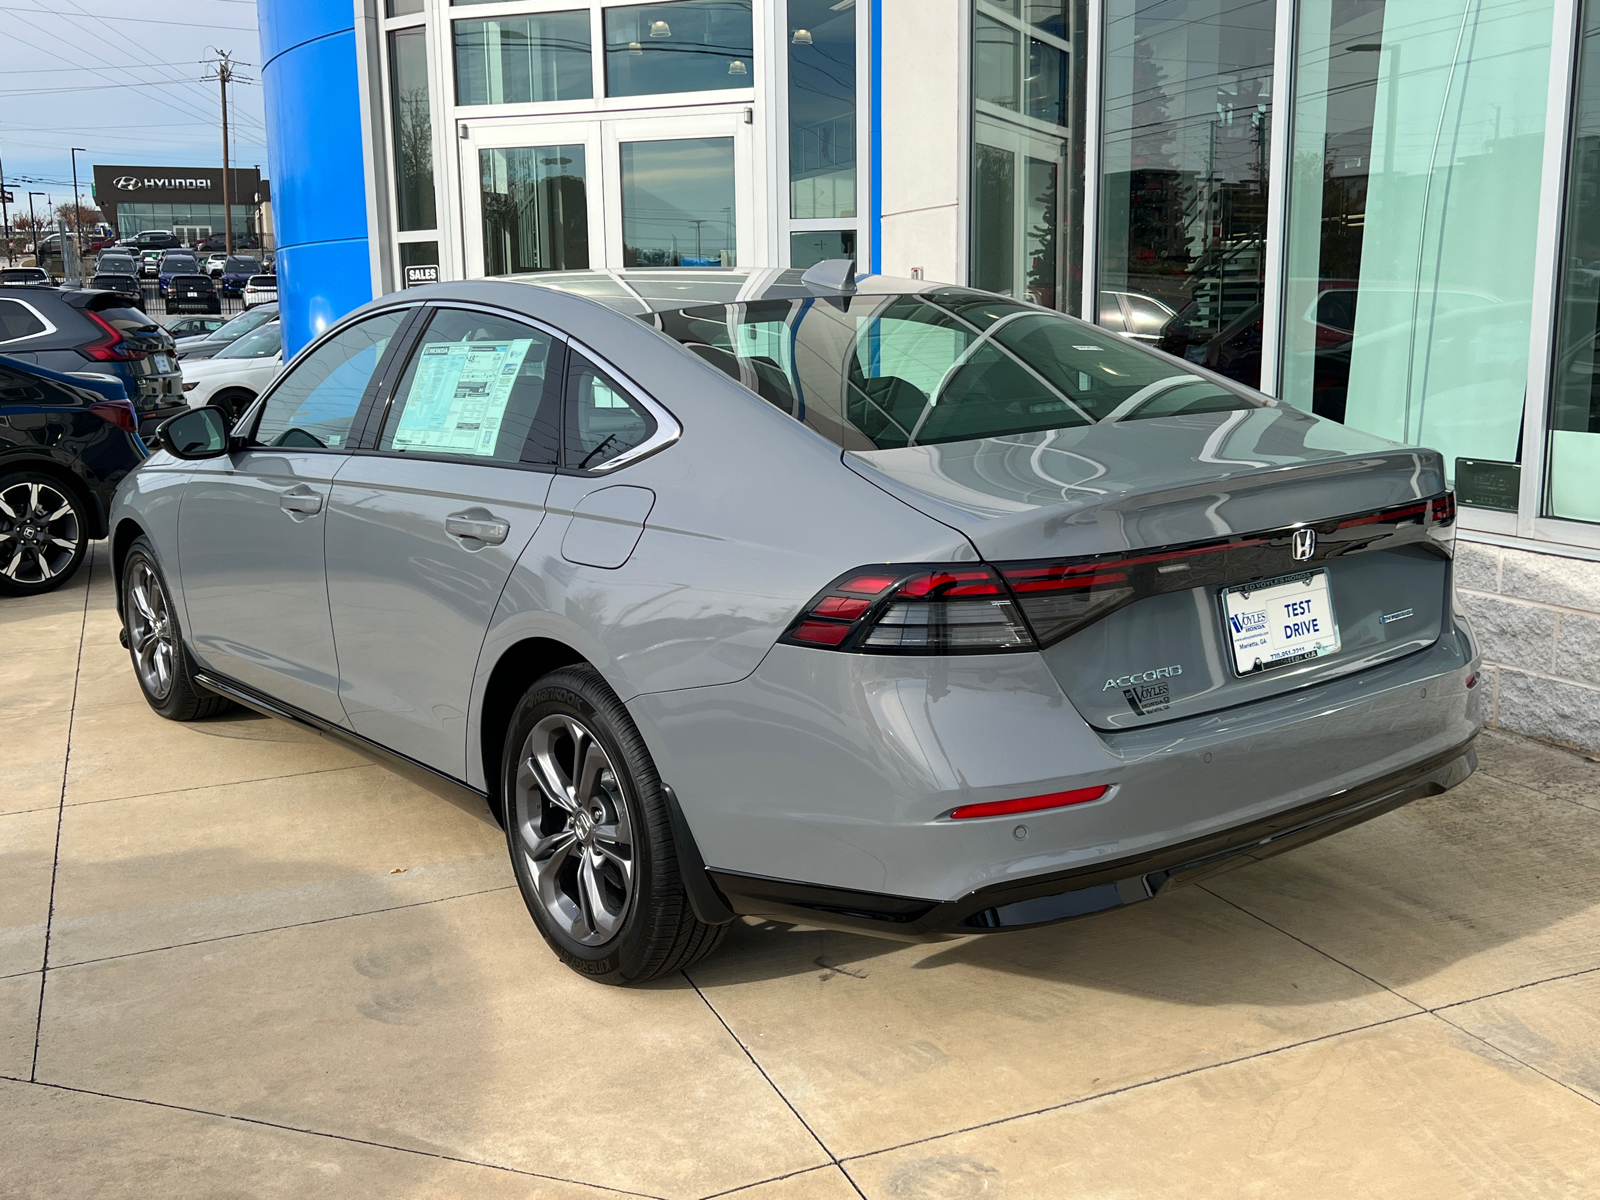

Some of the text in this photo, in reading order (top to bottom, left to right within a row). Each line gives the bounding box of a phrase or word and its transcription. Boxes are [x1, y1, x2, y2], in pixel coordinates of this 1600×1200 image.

[144, 178, 211, 189] HYUNDAI
[409, 269, 436, 280] SALES
[1284, 599, 1311, 618] TEST
[1234, 611, 1266, 631] VOYLES
[1245, 624, 1266, 633] HONDA
[1284, 618, 1320, 639] DRIVE
[1239, 641, 1259, 650] Marietta,
[1304, 650, 1317, 659] GA
[1102, 664, 1183, 691] ACCORD
[1132, 684, 1169, 704] VOYLES
[1141, 699, 1164, 709] HONDA
